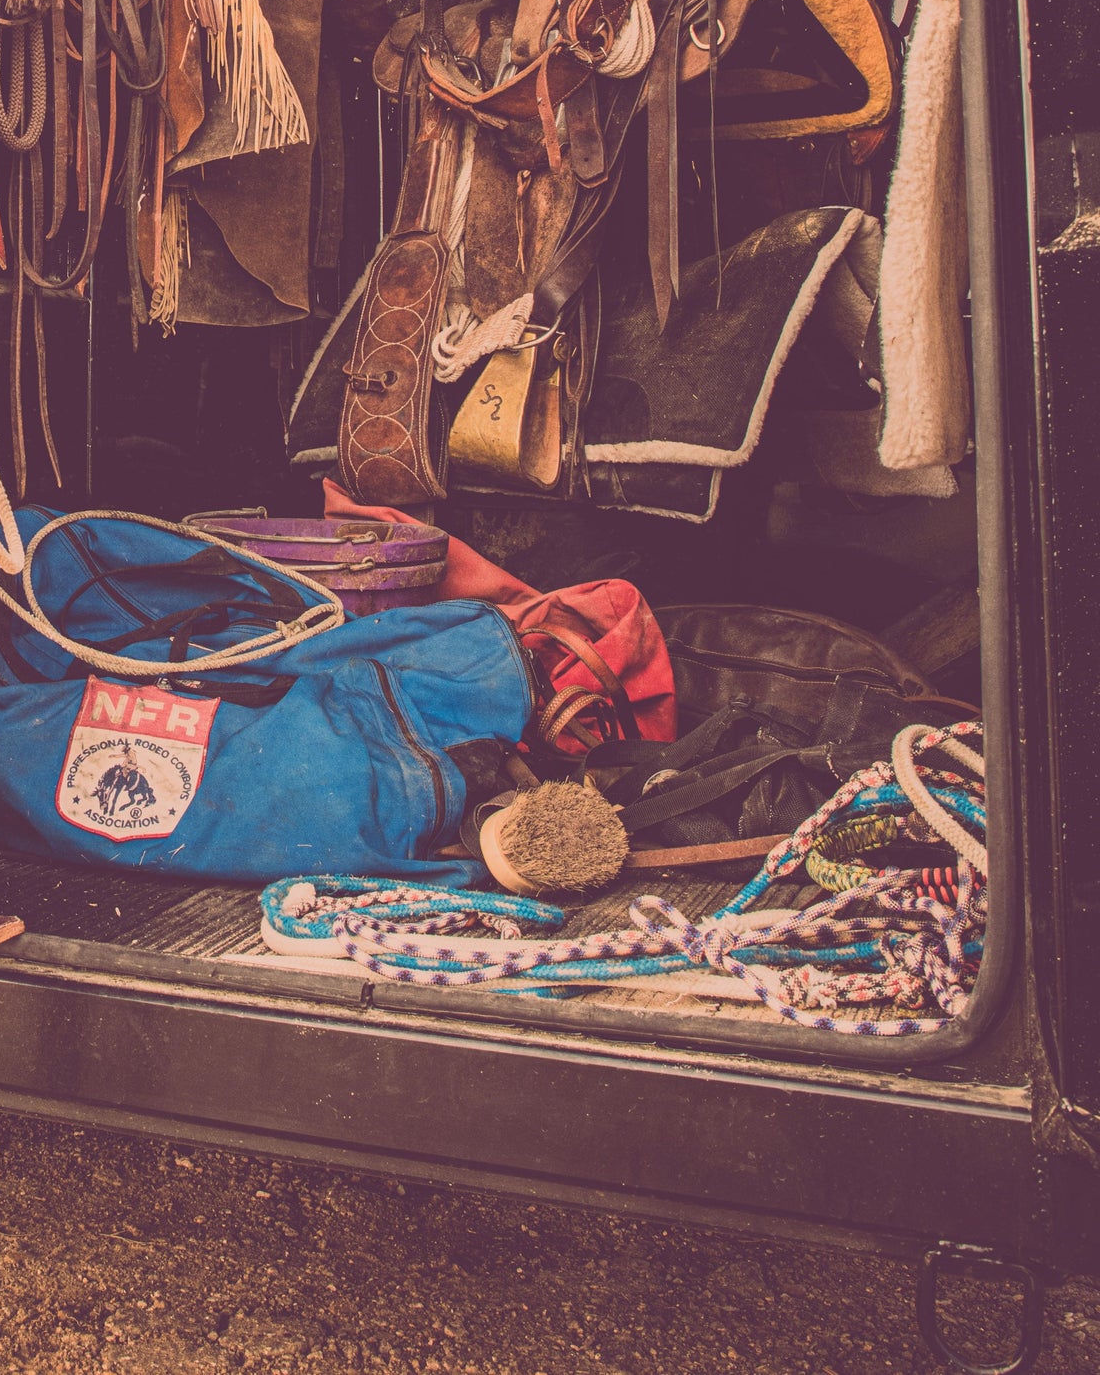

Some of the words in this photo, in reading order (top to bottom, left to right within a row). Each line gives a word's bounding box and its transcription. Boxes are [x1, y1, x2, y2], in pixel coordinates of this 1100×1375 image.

[91, 691, 200, 737] NFR
[67, 738, 131, 788] PROFESSIONAL
[134, 738, 170, 759] RODEO
[170, 757, 192, 801] COWBOYS
[84, 809, 160, 829] ASSOCIATION
